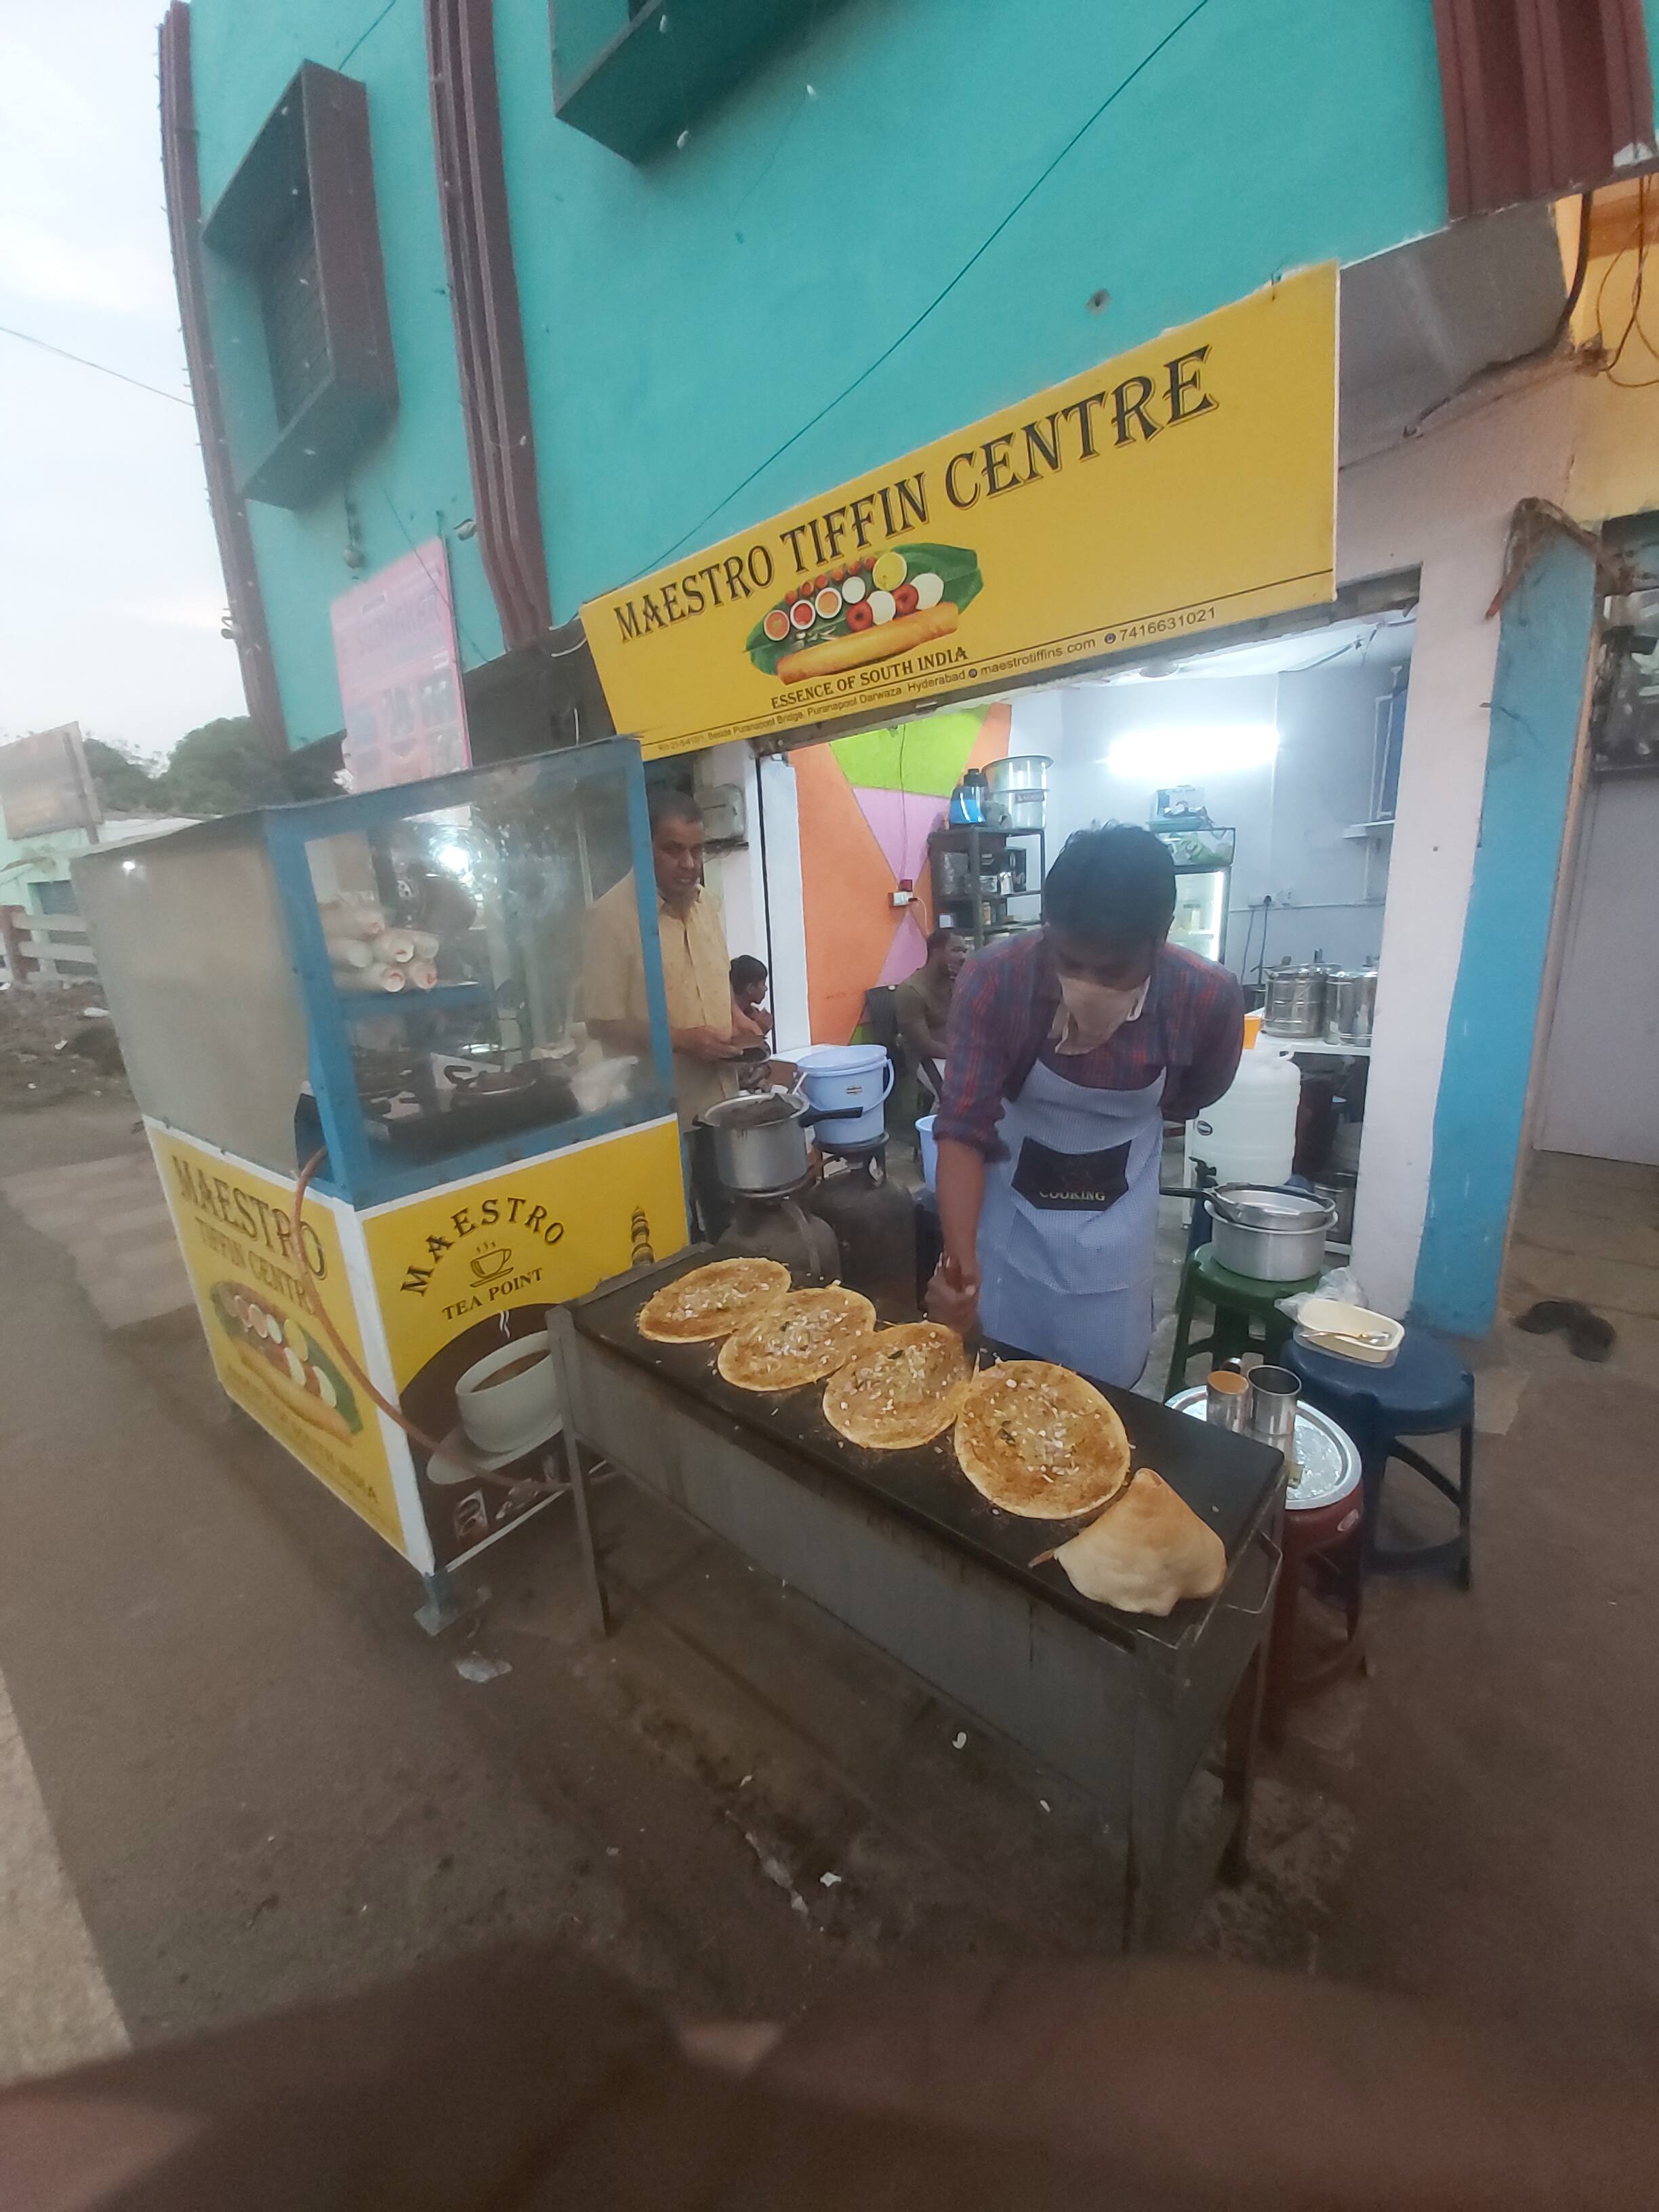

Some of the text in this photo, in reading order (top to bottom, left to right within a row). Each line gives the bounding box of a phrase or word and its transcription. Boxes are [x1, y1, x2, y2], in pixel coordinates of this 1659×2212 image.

[613, 344, 1221, 644] MAESTRO TIFFIN CENTRE
[771, 646, 969, 710] ESSENCE OF SOUTH INDIA
[807, 698, 857, 716] Puranapool
[907, 670, 966, 693] Hyderabad
[980, 637, 1097, 676] maestrotiffinscom
[1119, 607, 1216, 642] 7416631021
[172, 1154, 328, 1282] MAESTRO
[400, 1196, 565, 1297] MAESTRO
[248, 1250, 316, 1315] CENTR
[442, 1267, 543, 1319] TEA POINT
